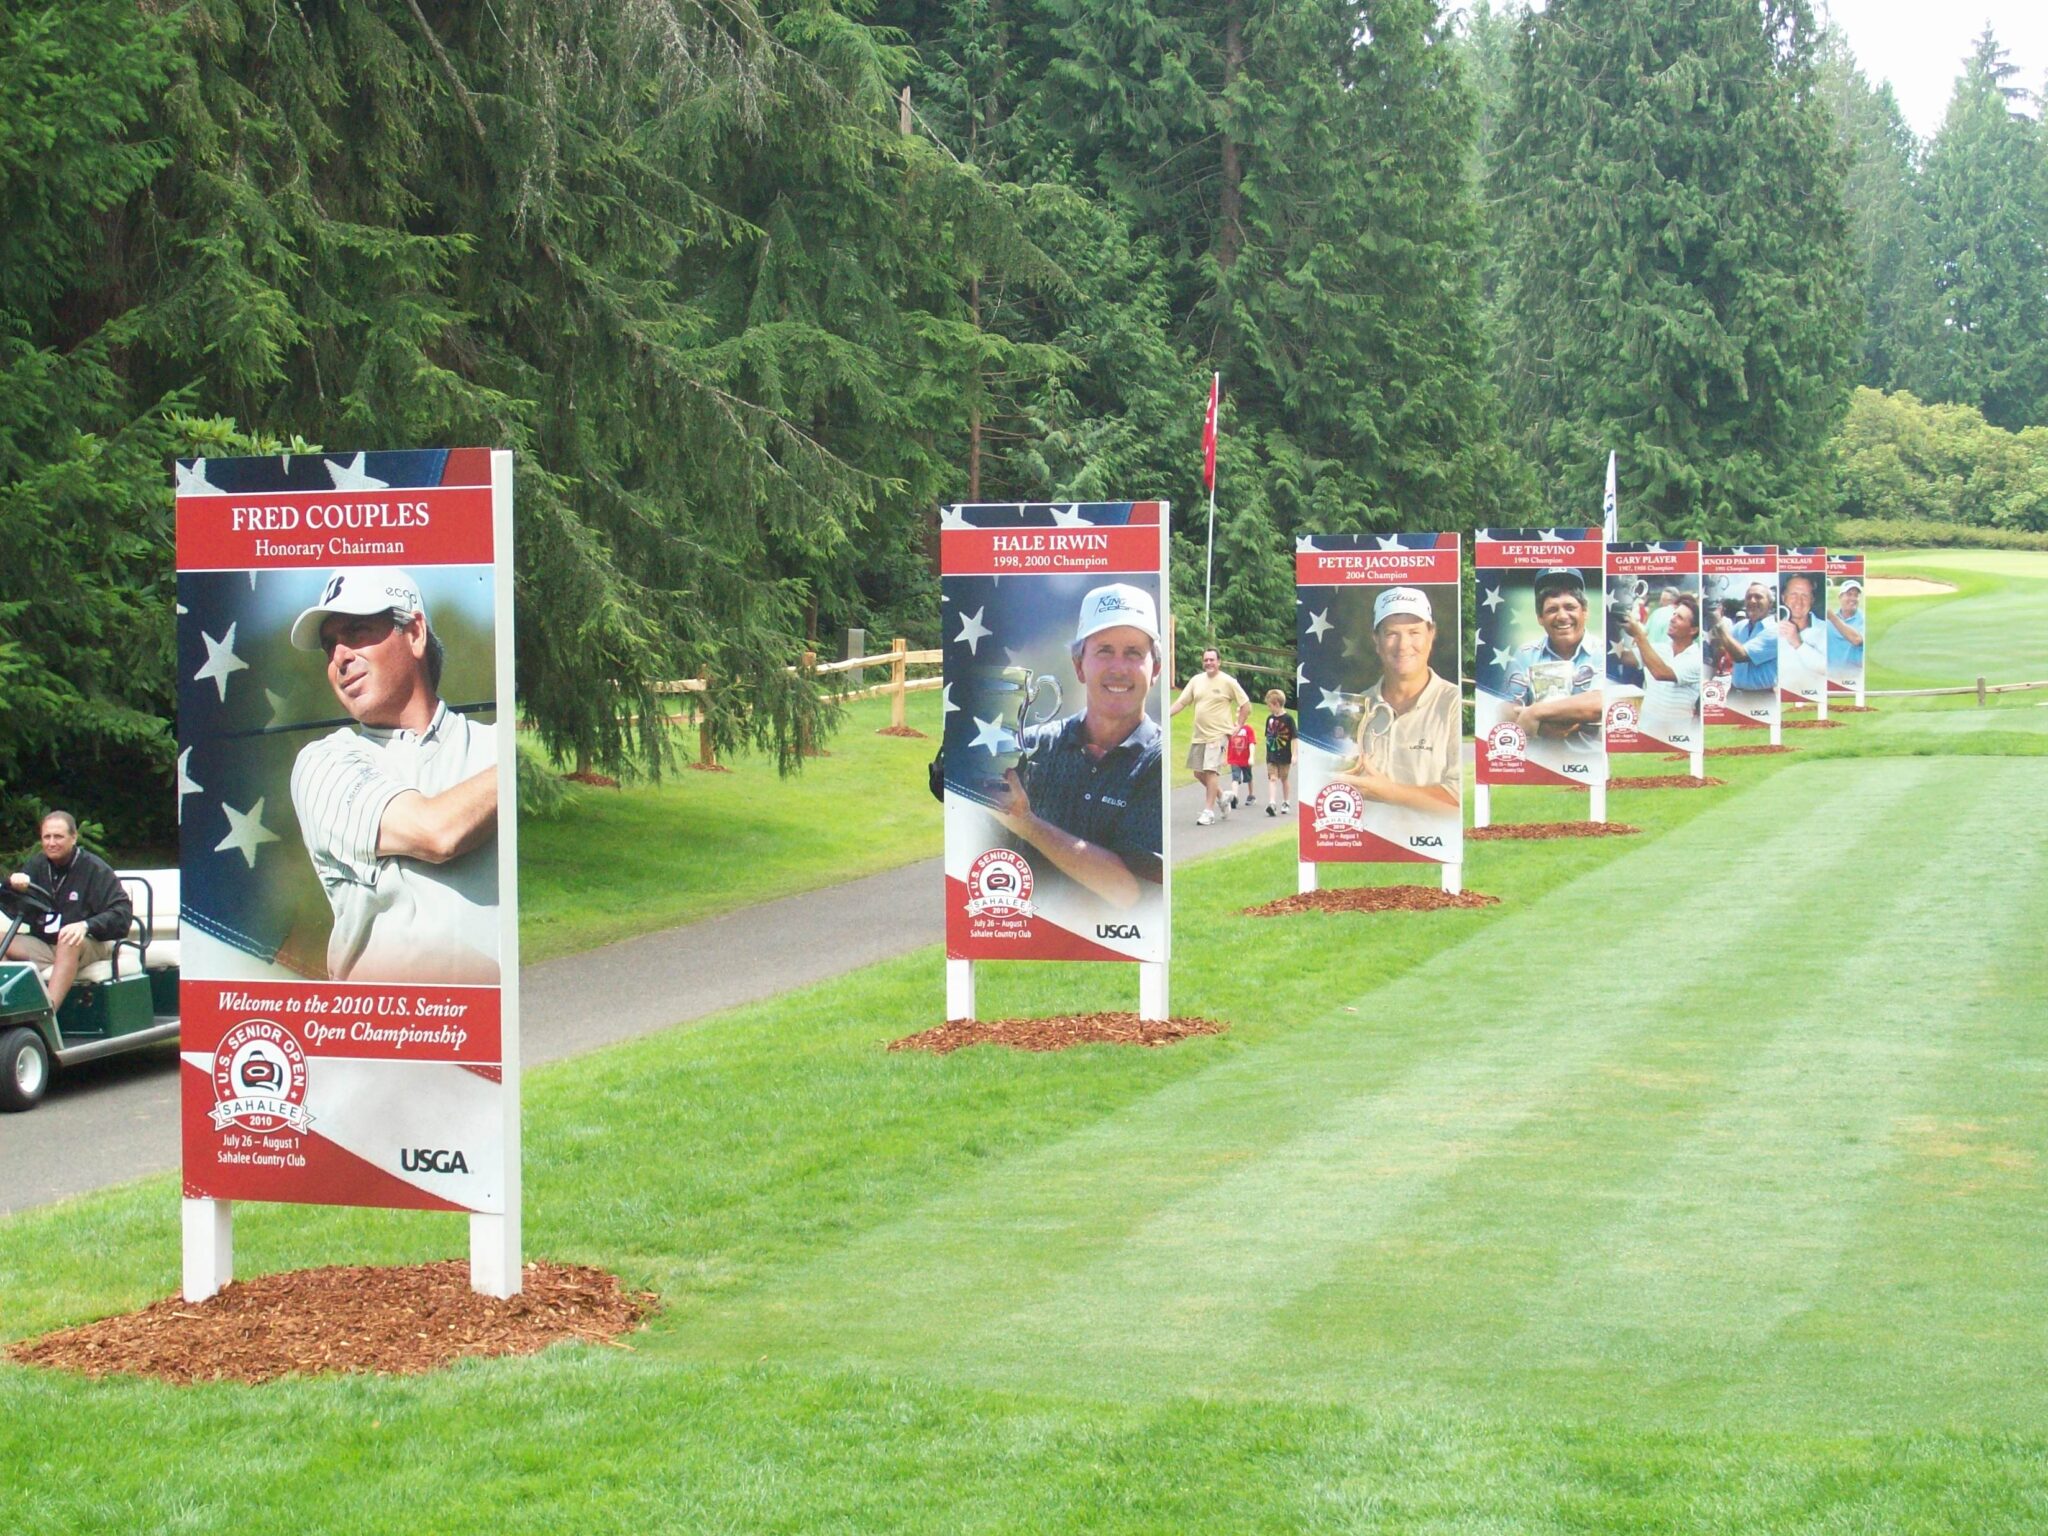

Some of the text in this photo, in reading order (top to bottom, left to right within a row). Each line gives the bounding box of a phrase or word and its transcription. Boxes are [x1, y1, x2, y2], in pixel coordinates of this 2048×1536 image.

[232, 502, 430, 531] FRED COUPLES
[255, 537, 404, 560] Honorary Chairman
[993, 534, 1108, 551] HALE IRWIN
[1502, 545, 1575, 555] LEE TREVINO
[993, 554, 1108, 569] 1998, 2000 Champion
[1318, 555, 1435, 570] PETER JACOBSEN
[1530, 557, 1563, 565] Champion
[1615, 555, 1677, 564] GARY PLAYER
[1734, 557, 1766, 565] PALMER
[1346, 570, 1408, 581] 2004 Champion
[1562, 764, 1589, 773] USGA
[1410, 836, 1443, 847] USGA
[977, 851, 1015, 868] SENIOR
[1015, 860, 1031, 890] OPEN
[973, 897, 1027, 909] SAHALEE
[974, 920, 986, 929] July
[1001, 920, 1022, 929] August
[1096, 924, 1140, 939] USGA
[970, 929, 1032, 940] Sahalee Country Club
[218, 991, 467, 1018] Welcome to the 2010 U.S. Senior
[304, 1020, 467, 1051] Open Championship
[217, 1024, 305, 1087] U.S. SENIOR OPEN
[222, 1099, 299, 1119] SAHALEE
[249, 1115, 273, 1126] 2010
[223, 1133, 240, 1149] July
[241, 1134, 252, 1147] 26
[262, 1135, 293, 1151] August
[294, 1137, 299, 1149] 1
[217, 1150, 306, 1168] Sahalee Country Club
[400, 1148, 470, 1175] USGA
